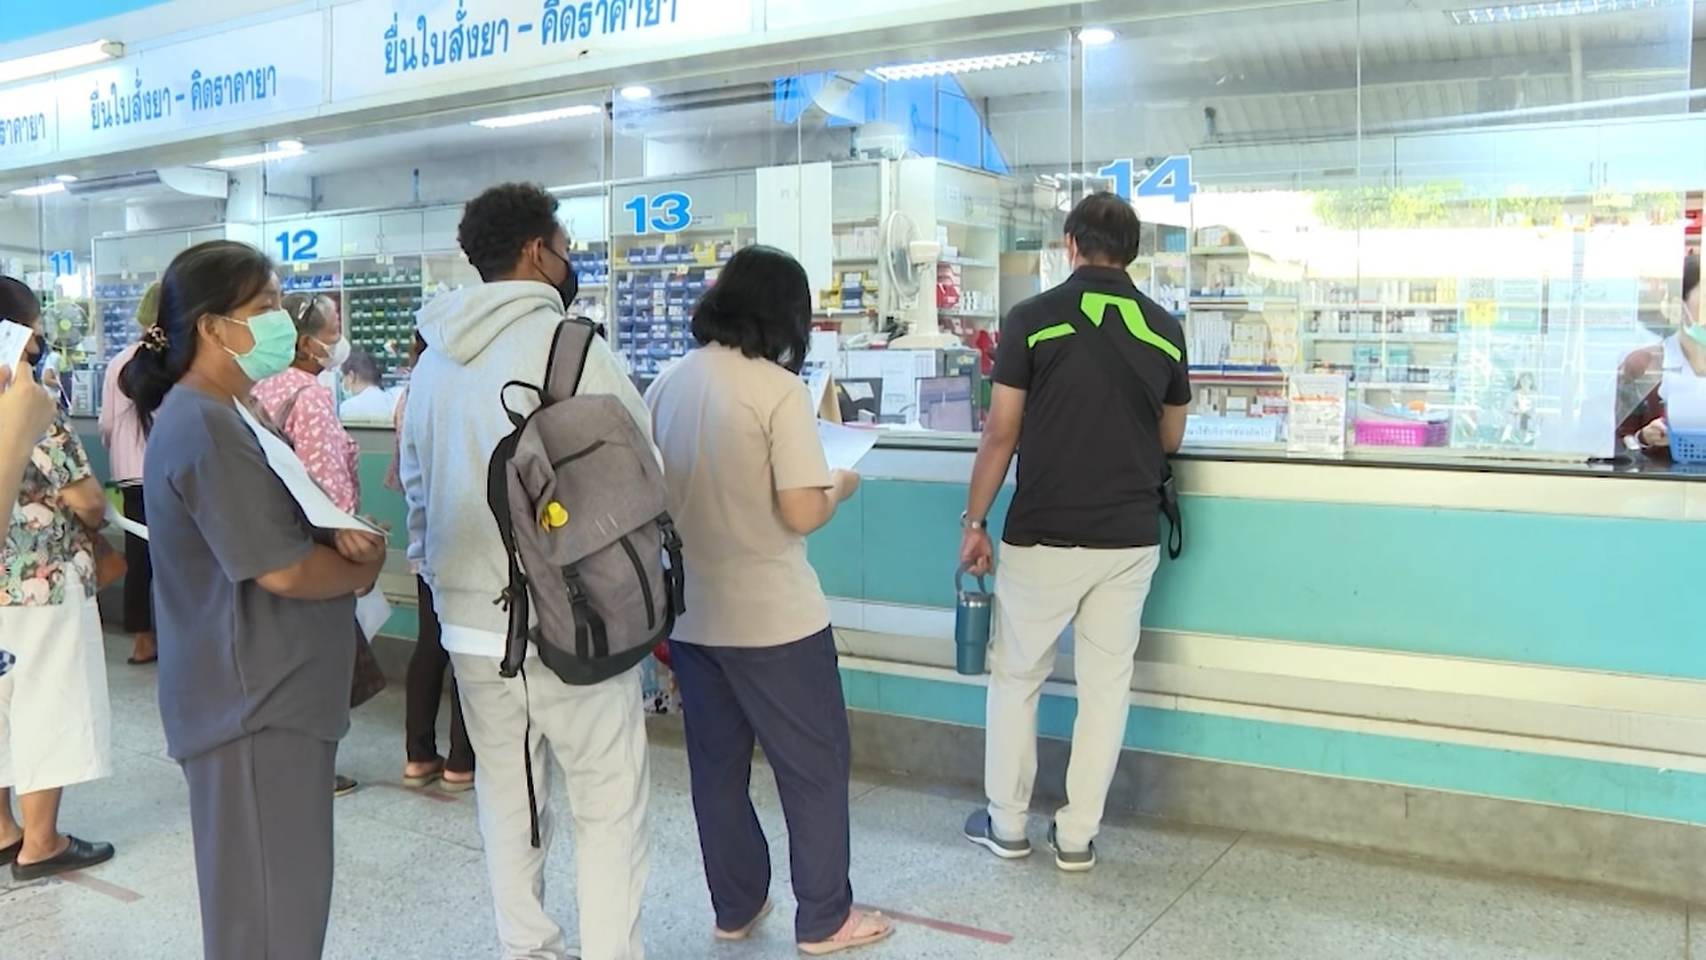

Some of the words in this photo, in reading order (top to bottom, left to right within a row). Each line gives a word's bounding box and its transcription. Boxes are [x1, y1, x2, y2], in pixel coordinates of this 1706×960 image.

[384, 0, 509, 74] ยื่นใบสั่งยา
[90, 68, 171, 130] ยื่นใบสั่งยา
[191, 65, 277, 110] คิดราคายา
[1096, 154, 1199, 202] 14
[624, 191, 692, 235] 13
[49, 250, 74, 276] 11
[276, 229, 318, 261] 12
